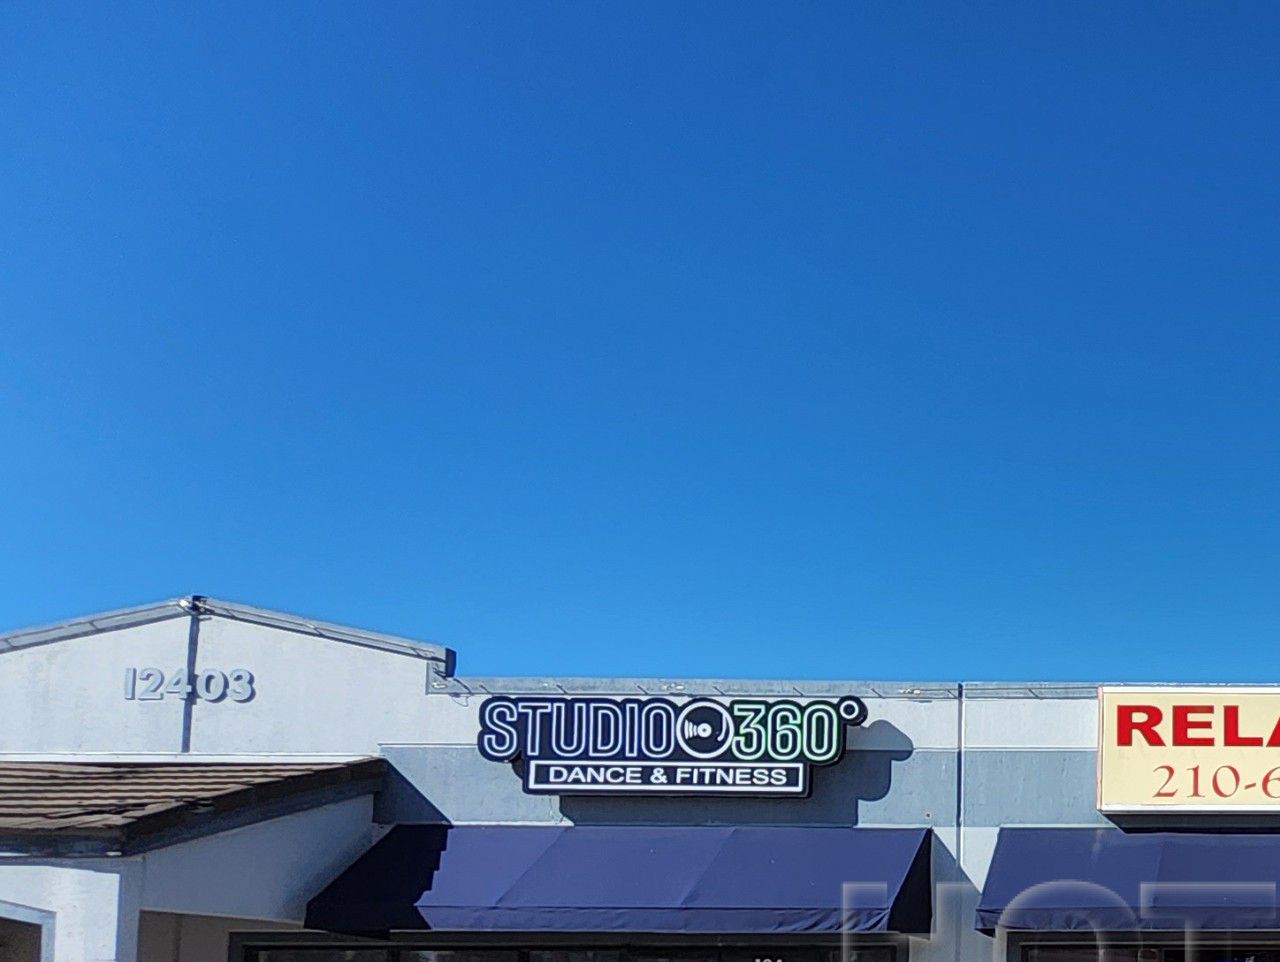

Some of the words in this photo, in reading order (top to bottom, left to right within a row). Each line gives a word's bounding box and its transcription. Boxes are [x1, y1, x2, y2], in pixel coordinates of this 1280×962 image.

[125, 667, 255, 702] 12403
[484, 701, 675, 758] STUDIO
[549, 766, 642, 784] DANCE
[650, 767, 668, 784] &
[675, 768, 788, 786] FITNESS
